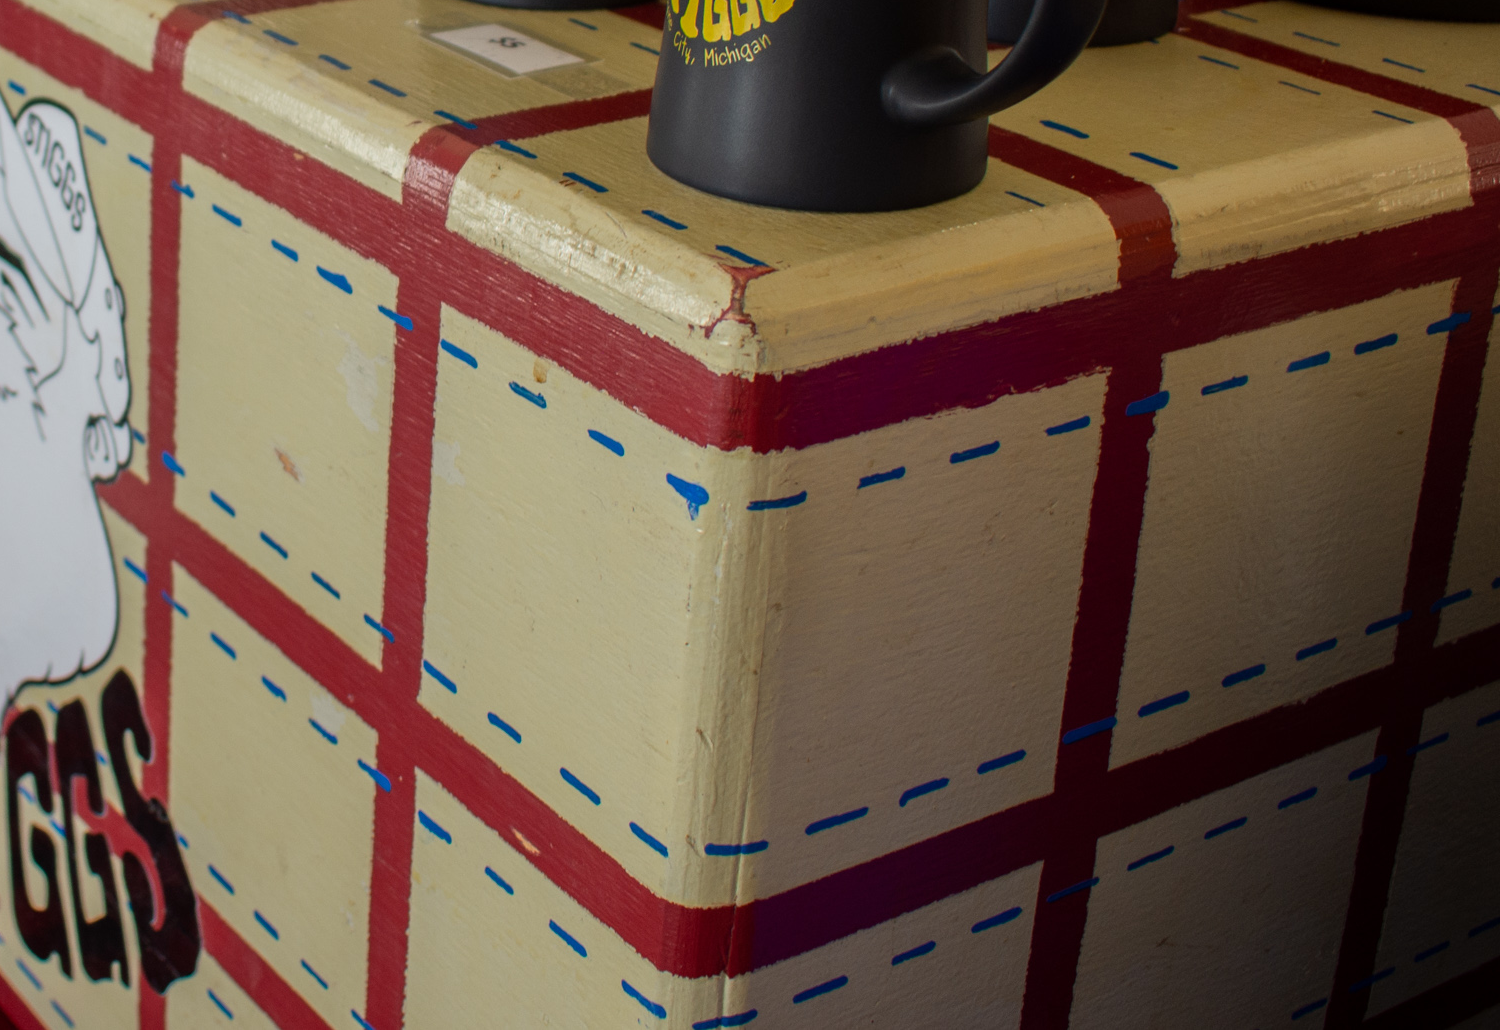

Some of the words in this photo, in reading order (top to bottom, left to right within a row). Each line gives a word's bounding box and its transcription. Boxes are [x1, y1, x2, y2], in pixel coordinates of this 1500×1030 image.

[673, 30, 696, 66] City,
[704, 33, 772, 68] Michigan
[23, 111, 86, 233] STIGGS
